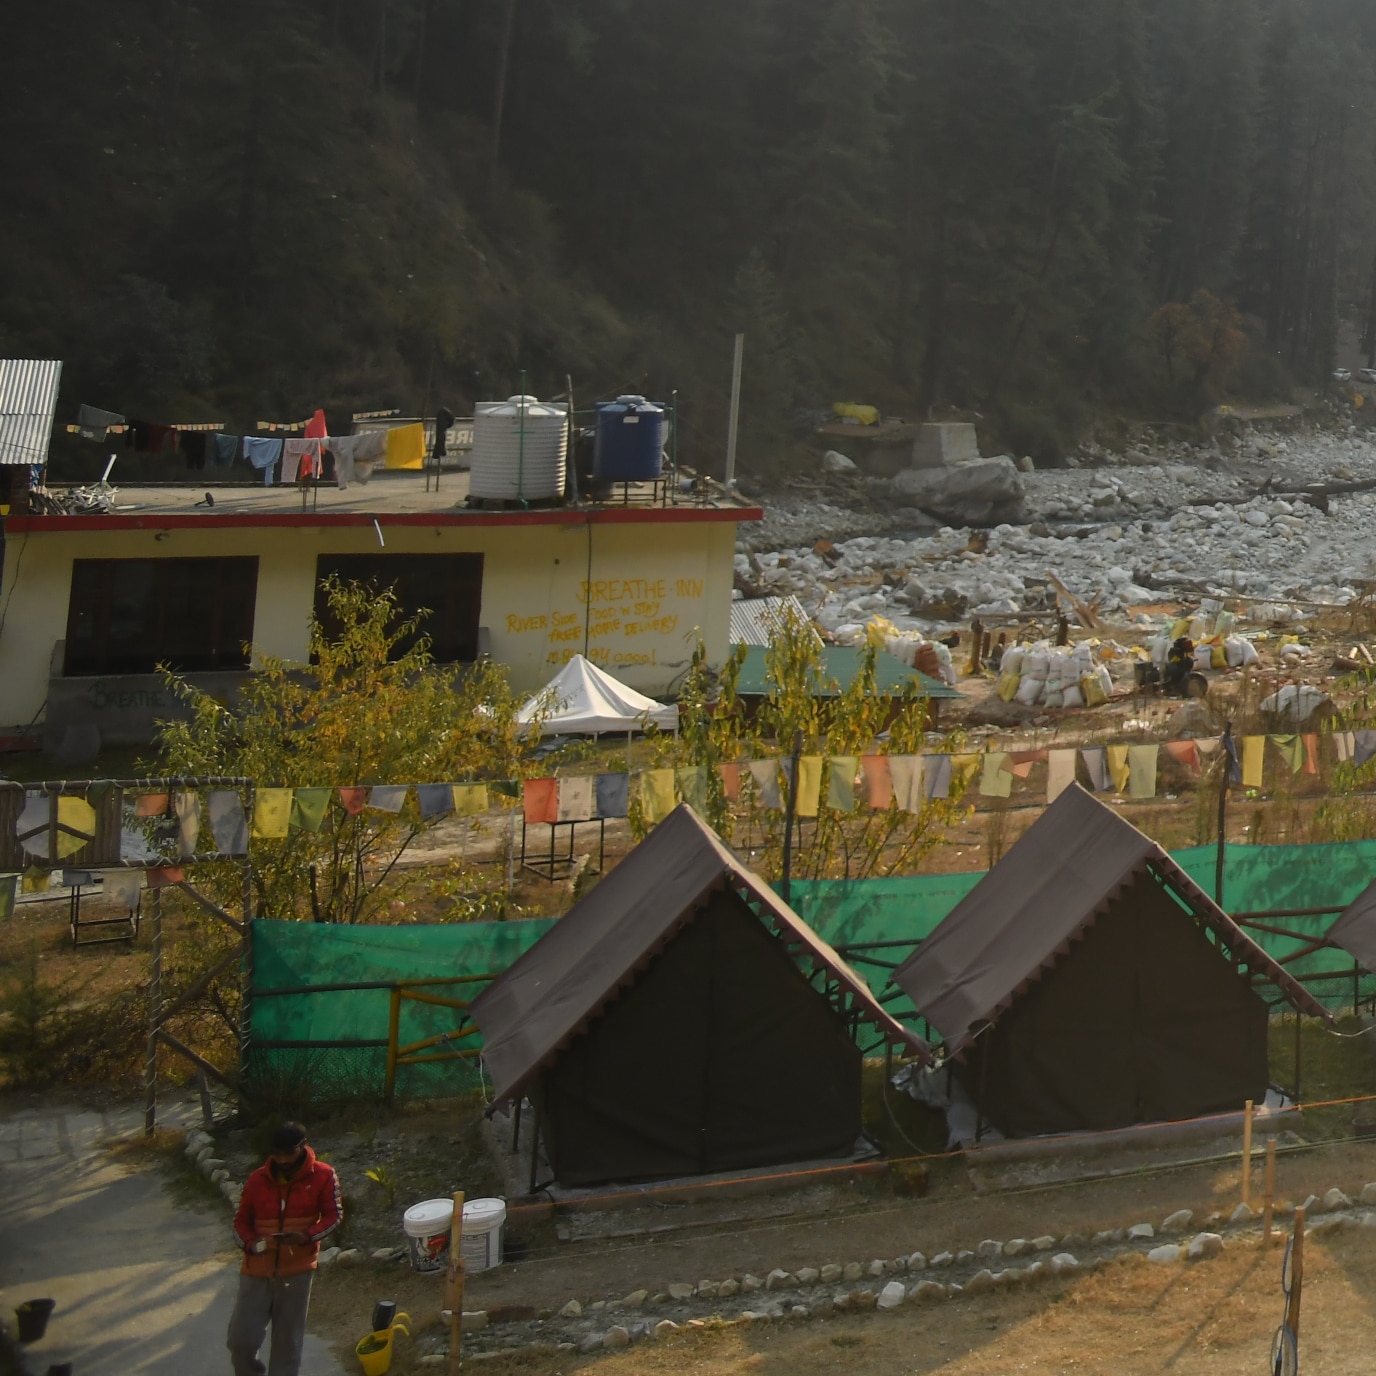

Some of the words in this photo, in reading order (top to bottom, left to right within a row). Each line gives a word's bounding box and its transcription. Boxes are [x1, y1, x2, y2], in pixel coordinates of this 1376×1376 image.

[676, 578, 703, 598] INN
[506, 613, 547, 633] RIVER
[634, 601, 660, 617] STAY
[624, 614, 678, 636] DELIVERY
